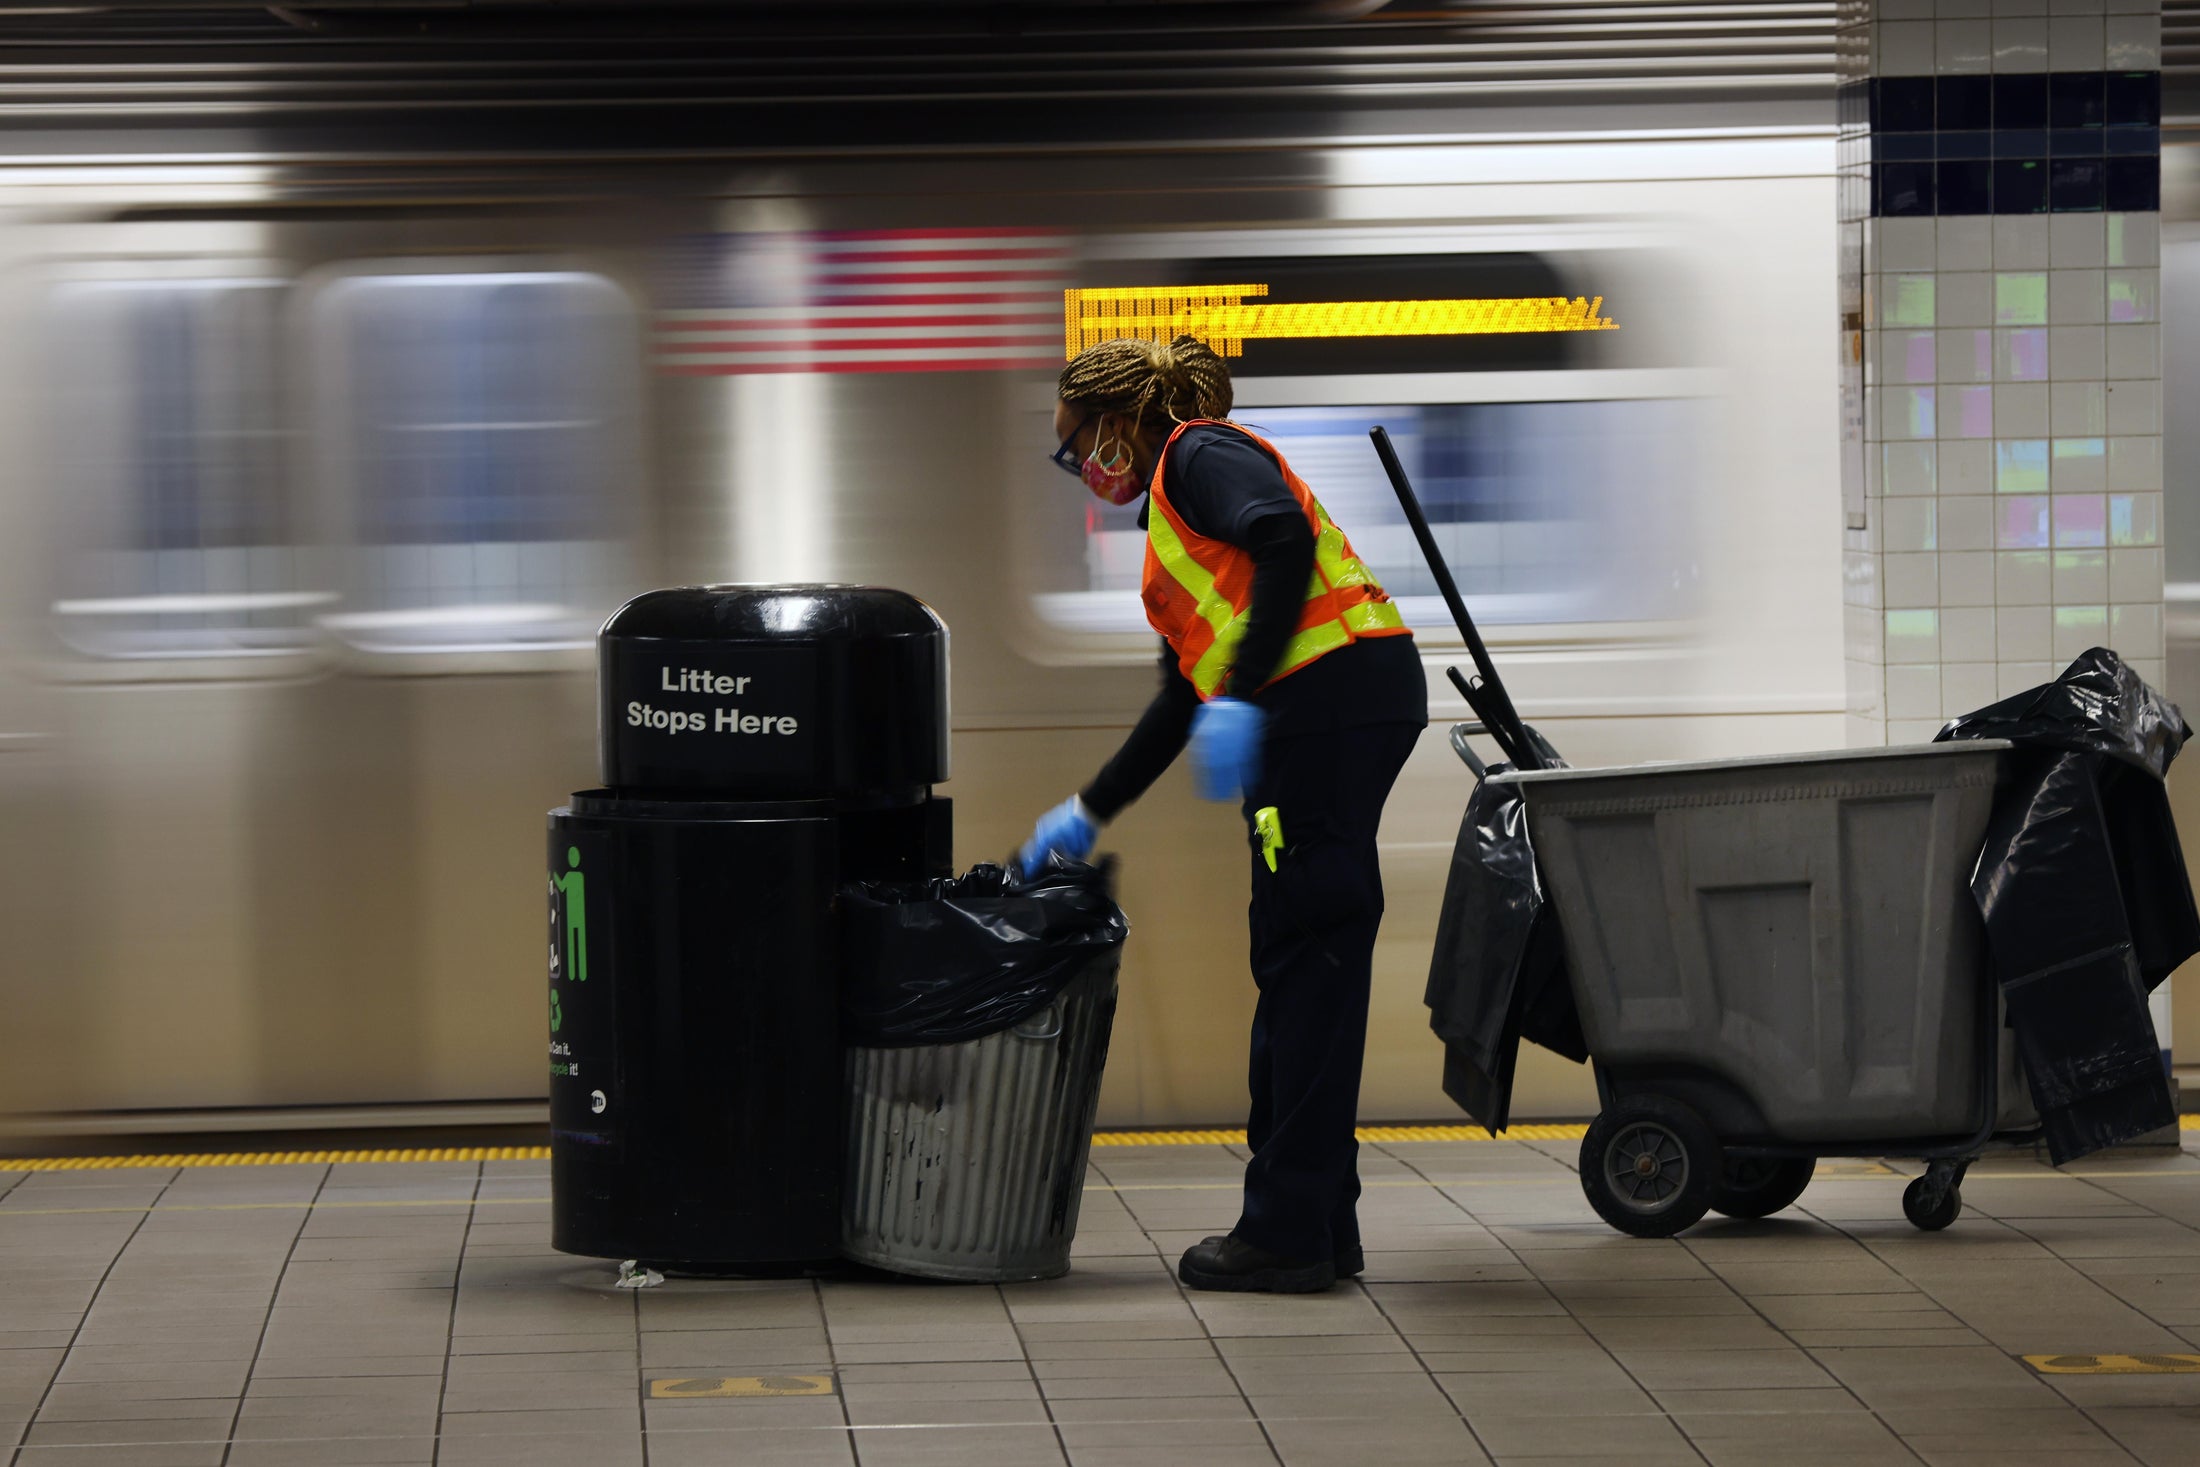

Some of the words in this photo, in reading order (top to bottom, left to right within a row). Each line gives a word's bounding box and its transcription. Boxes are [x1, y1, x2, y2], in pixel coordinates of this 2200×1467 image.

[661, 666, 751, 695] Litter
[627, 701, 706, 735] Stops
[714, 708, 798, 735] Here
